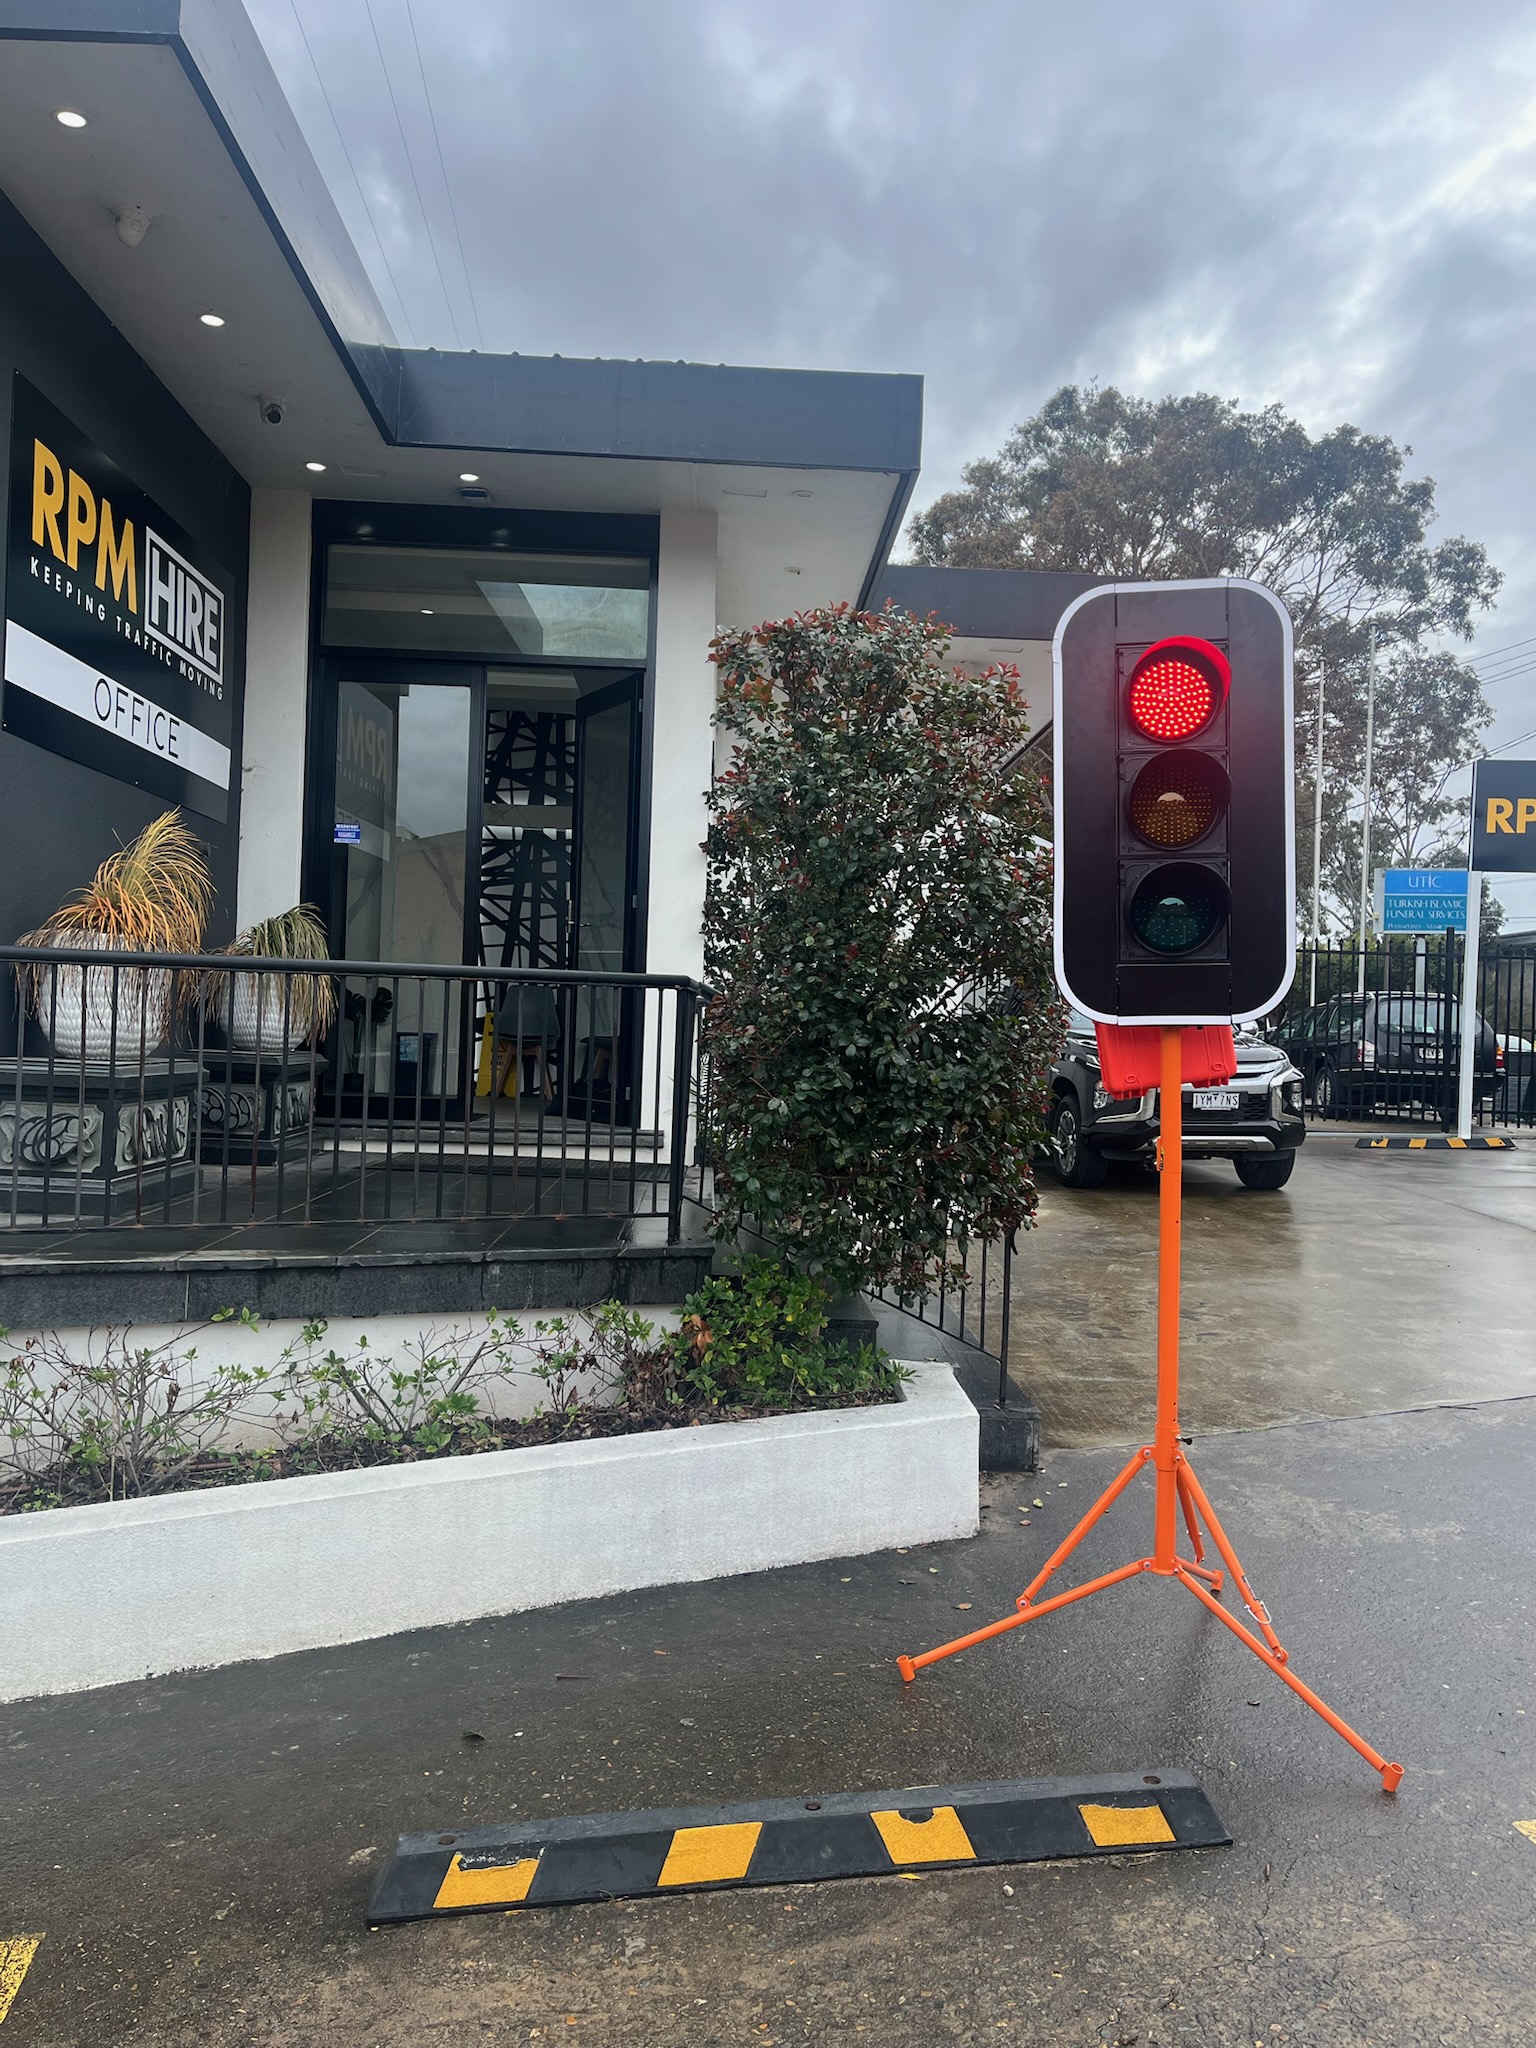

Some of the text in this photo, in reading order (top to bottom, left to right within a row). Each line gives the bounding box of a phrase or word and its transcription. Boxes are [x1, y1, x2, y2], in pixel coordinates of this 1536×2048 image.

[31, 438, 220, 669] RPM HIRE
[30, 556, 224, 701] KEEPING TRAFFIC MOVING
[94, 678, 181, 760] OFFICE
[1386, 910, 1466, 919] FUNERAL SERVICES
[1389, 899, 1465, 909] TURKISH ISLAMIC
